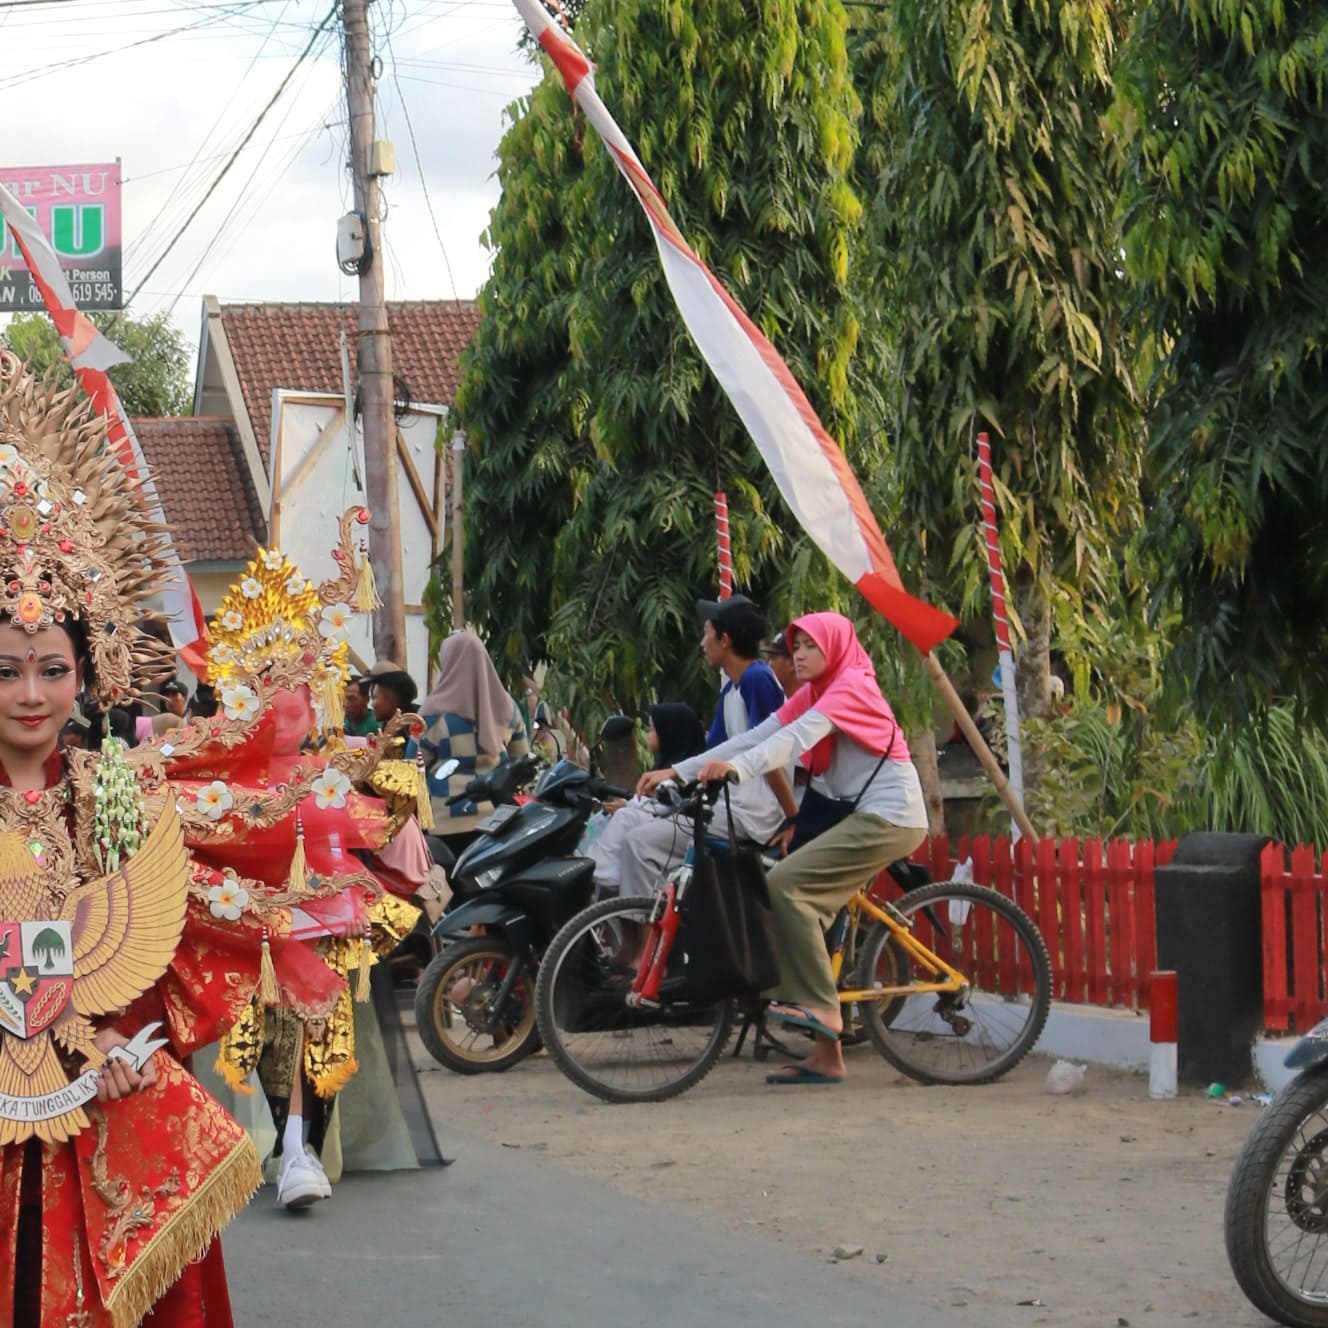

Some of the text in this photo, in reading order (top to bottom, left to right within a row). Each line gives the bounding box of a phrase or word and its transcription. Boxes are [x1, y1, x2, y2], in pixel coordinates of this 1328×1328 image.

[50, 172, 108, 196] NU
[73, 269, 110, 281] Person
[72, 283, 92, 302] 619
[94, 282, 114, 302] 545
[22, 1090, 80, 1117] TUNGGAL
